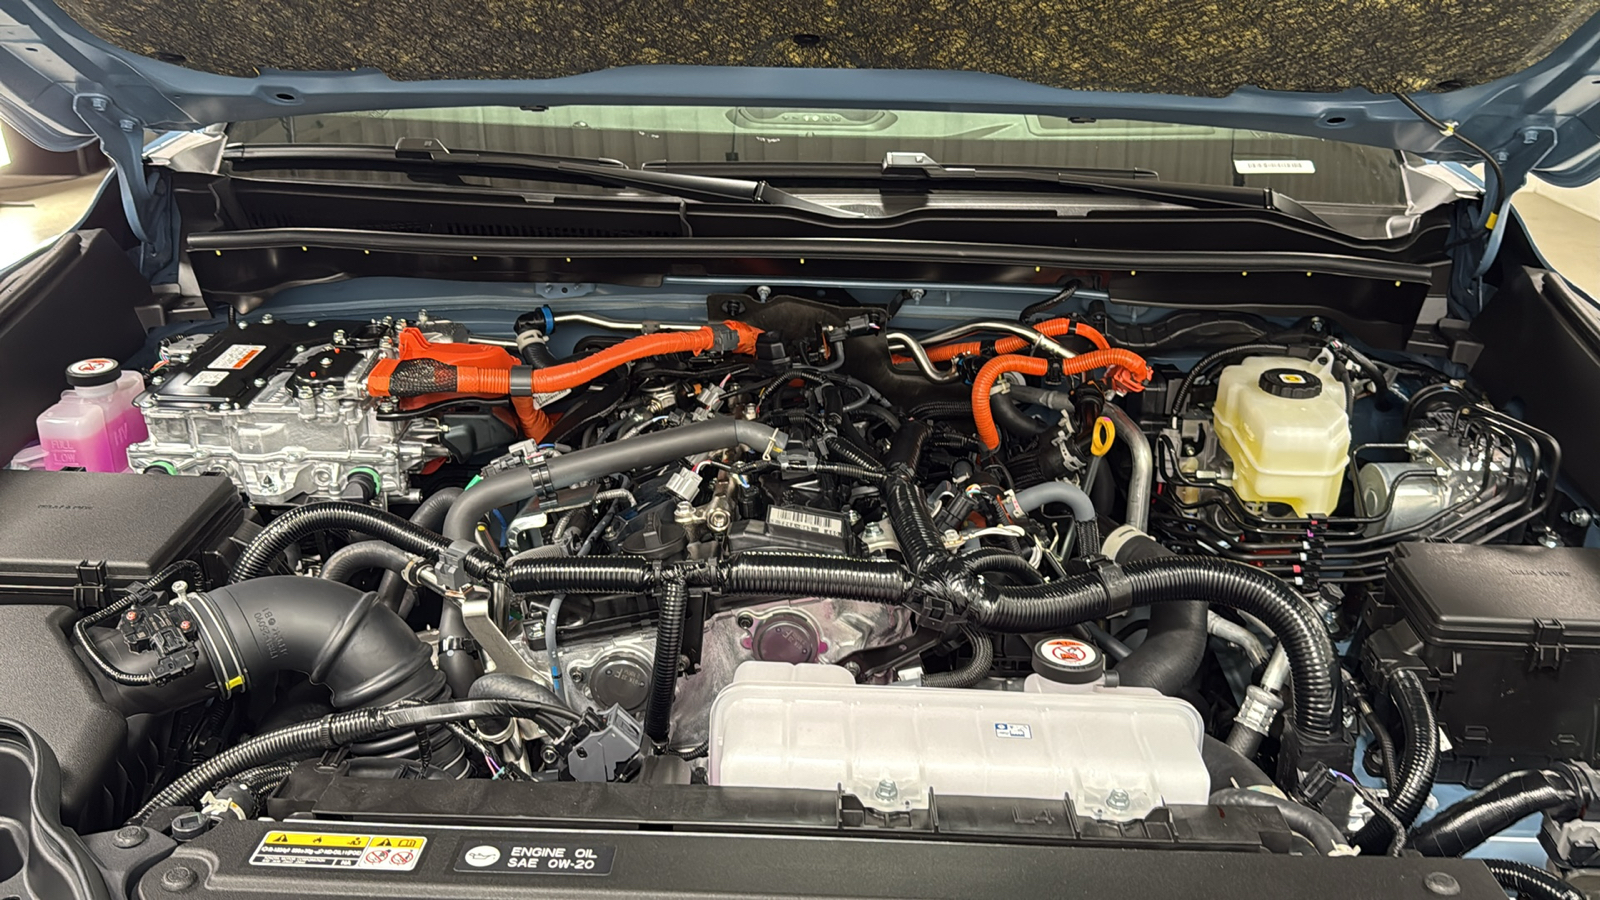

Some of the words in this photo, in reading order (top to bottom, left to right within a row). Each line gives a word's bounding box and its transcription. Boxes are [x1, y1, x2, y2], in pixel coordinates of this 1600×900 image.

[51, 440, 74, 449] FULL
[53, 453, 76, 463] LOW
[511, 846, 566, 858] ENGINE
[574, 848, 598, 859] OIL
[507, 857, 539, 868] SAE
[547, 858, 595, 869] 0W-20
